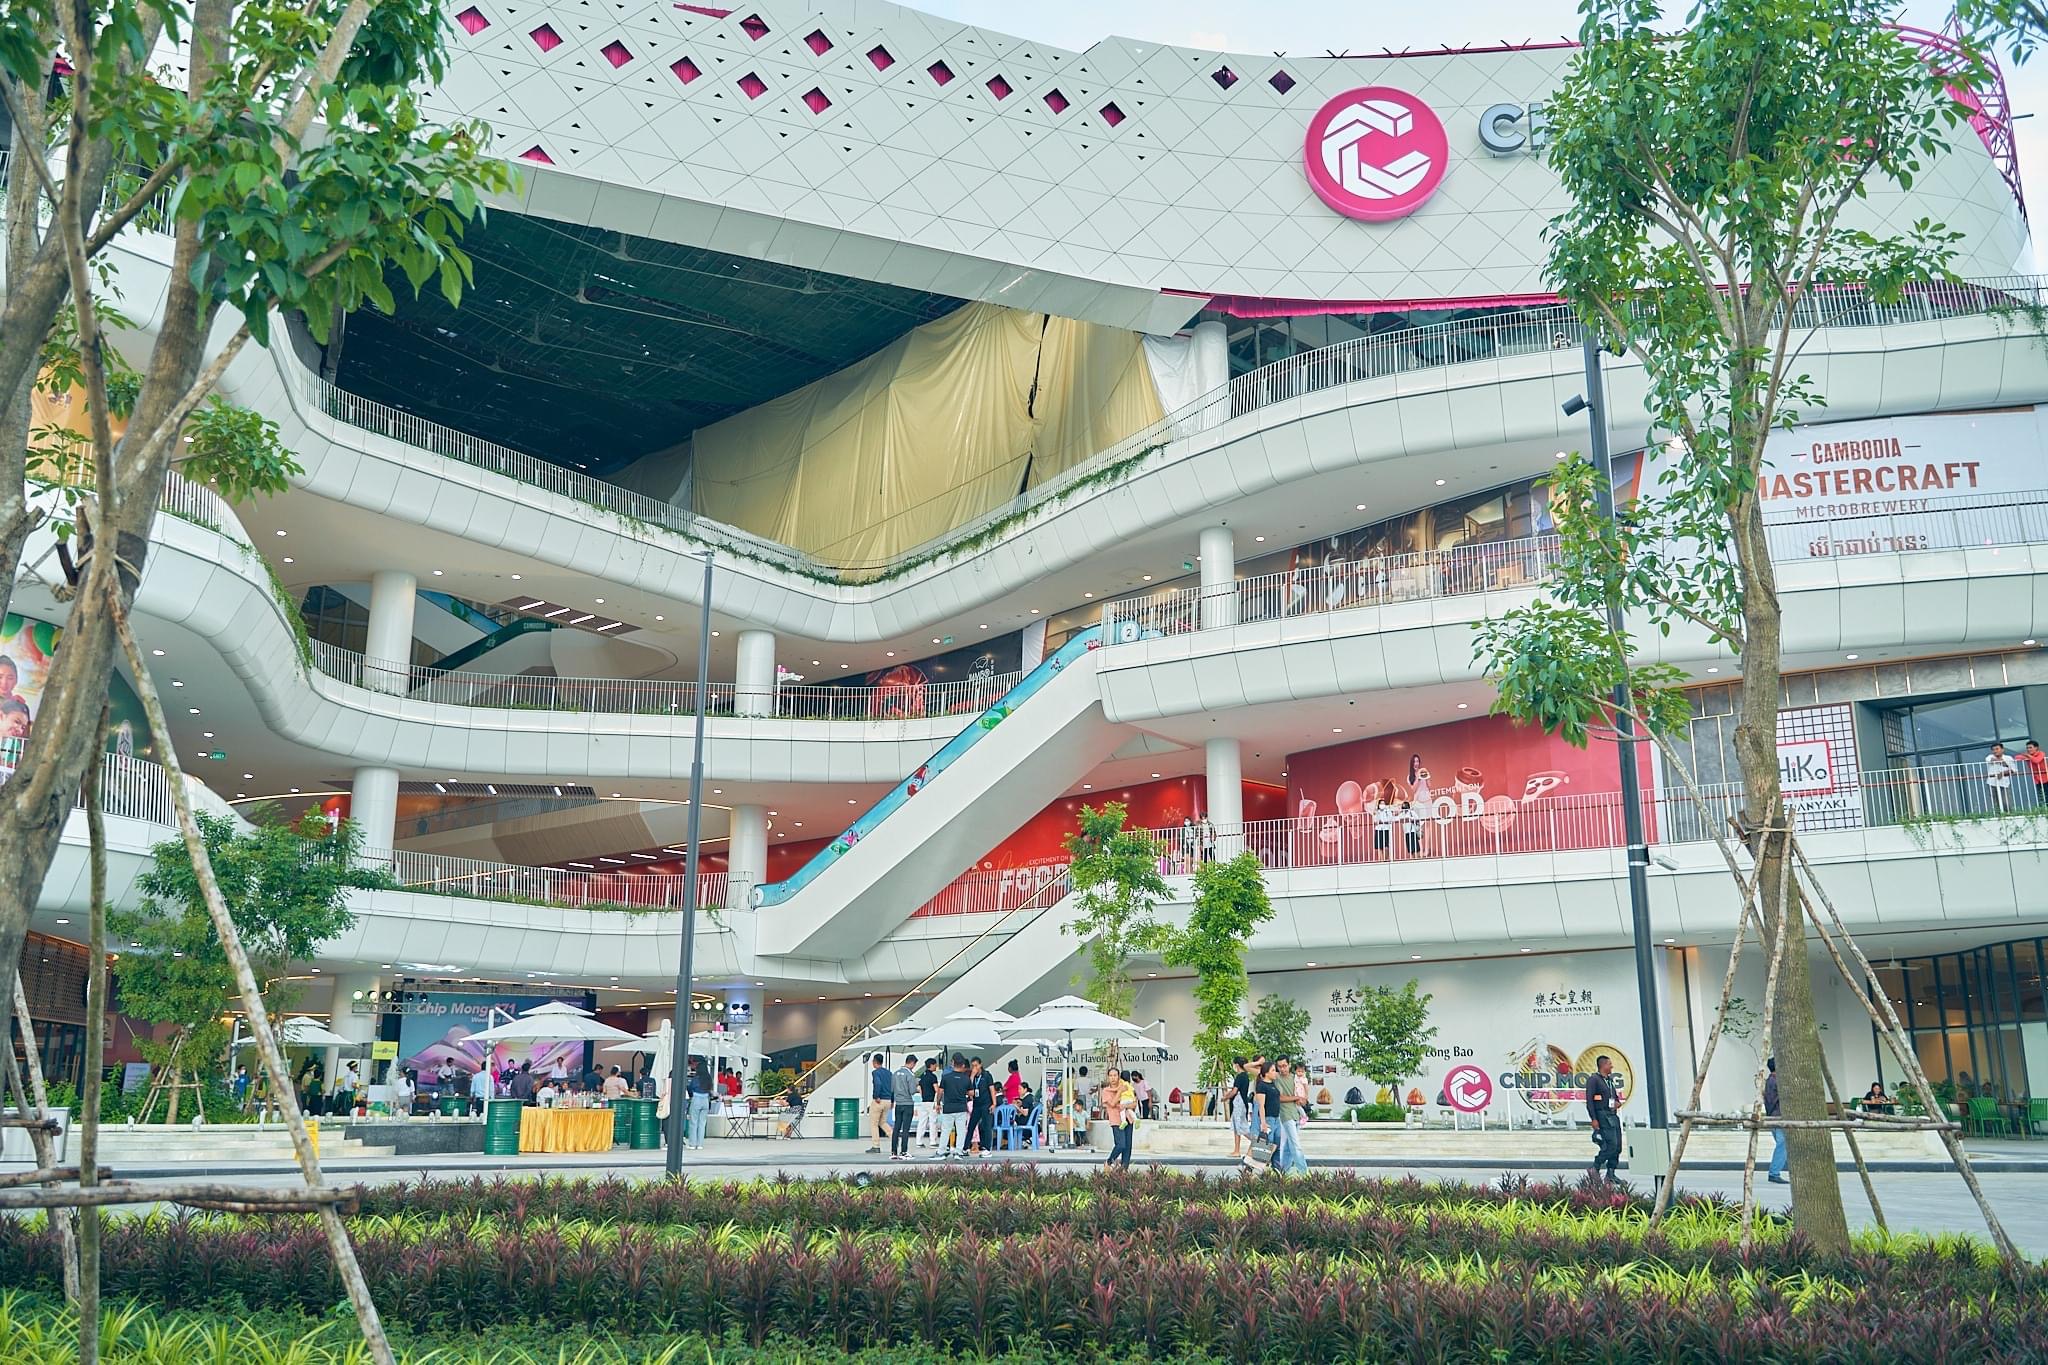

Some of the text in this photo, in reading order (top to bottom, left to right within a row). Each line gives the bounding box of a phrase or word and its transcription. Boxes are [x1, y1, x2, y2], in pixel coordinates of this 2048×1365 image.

[1812, 438, 1902, 465] CAMBODIA
[1796, 498, 1929, 519] MICROBREWERY
[1029, 857, 1059, 866] EXCITEMENT
[451, 1002, 488, 1017] Mong
[1025, 1055, 1030, 1064] 8
[1123, 1052, 1140, 1063] Xiao
[1142, 1052, 1162, 1065] Long
[1161, 1053, 1179, 1063] ao
[1453, 1046, 1474, 1057] Bao
[1556, 1072, 1625, 1090] MOG
